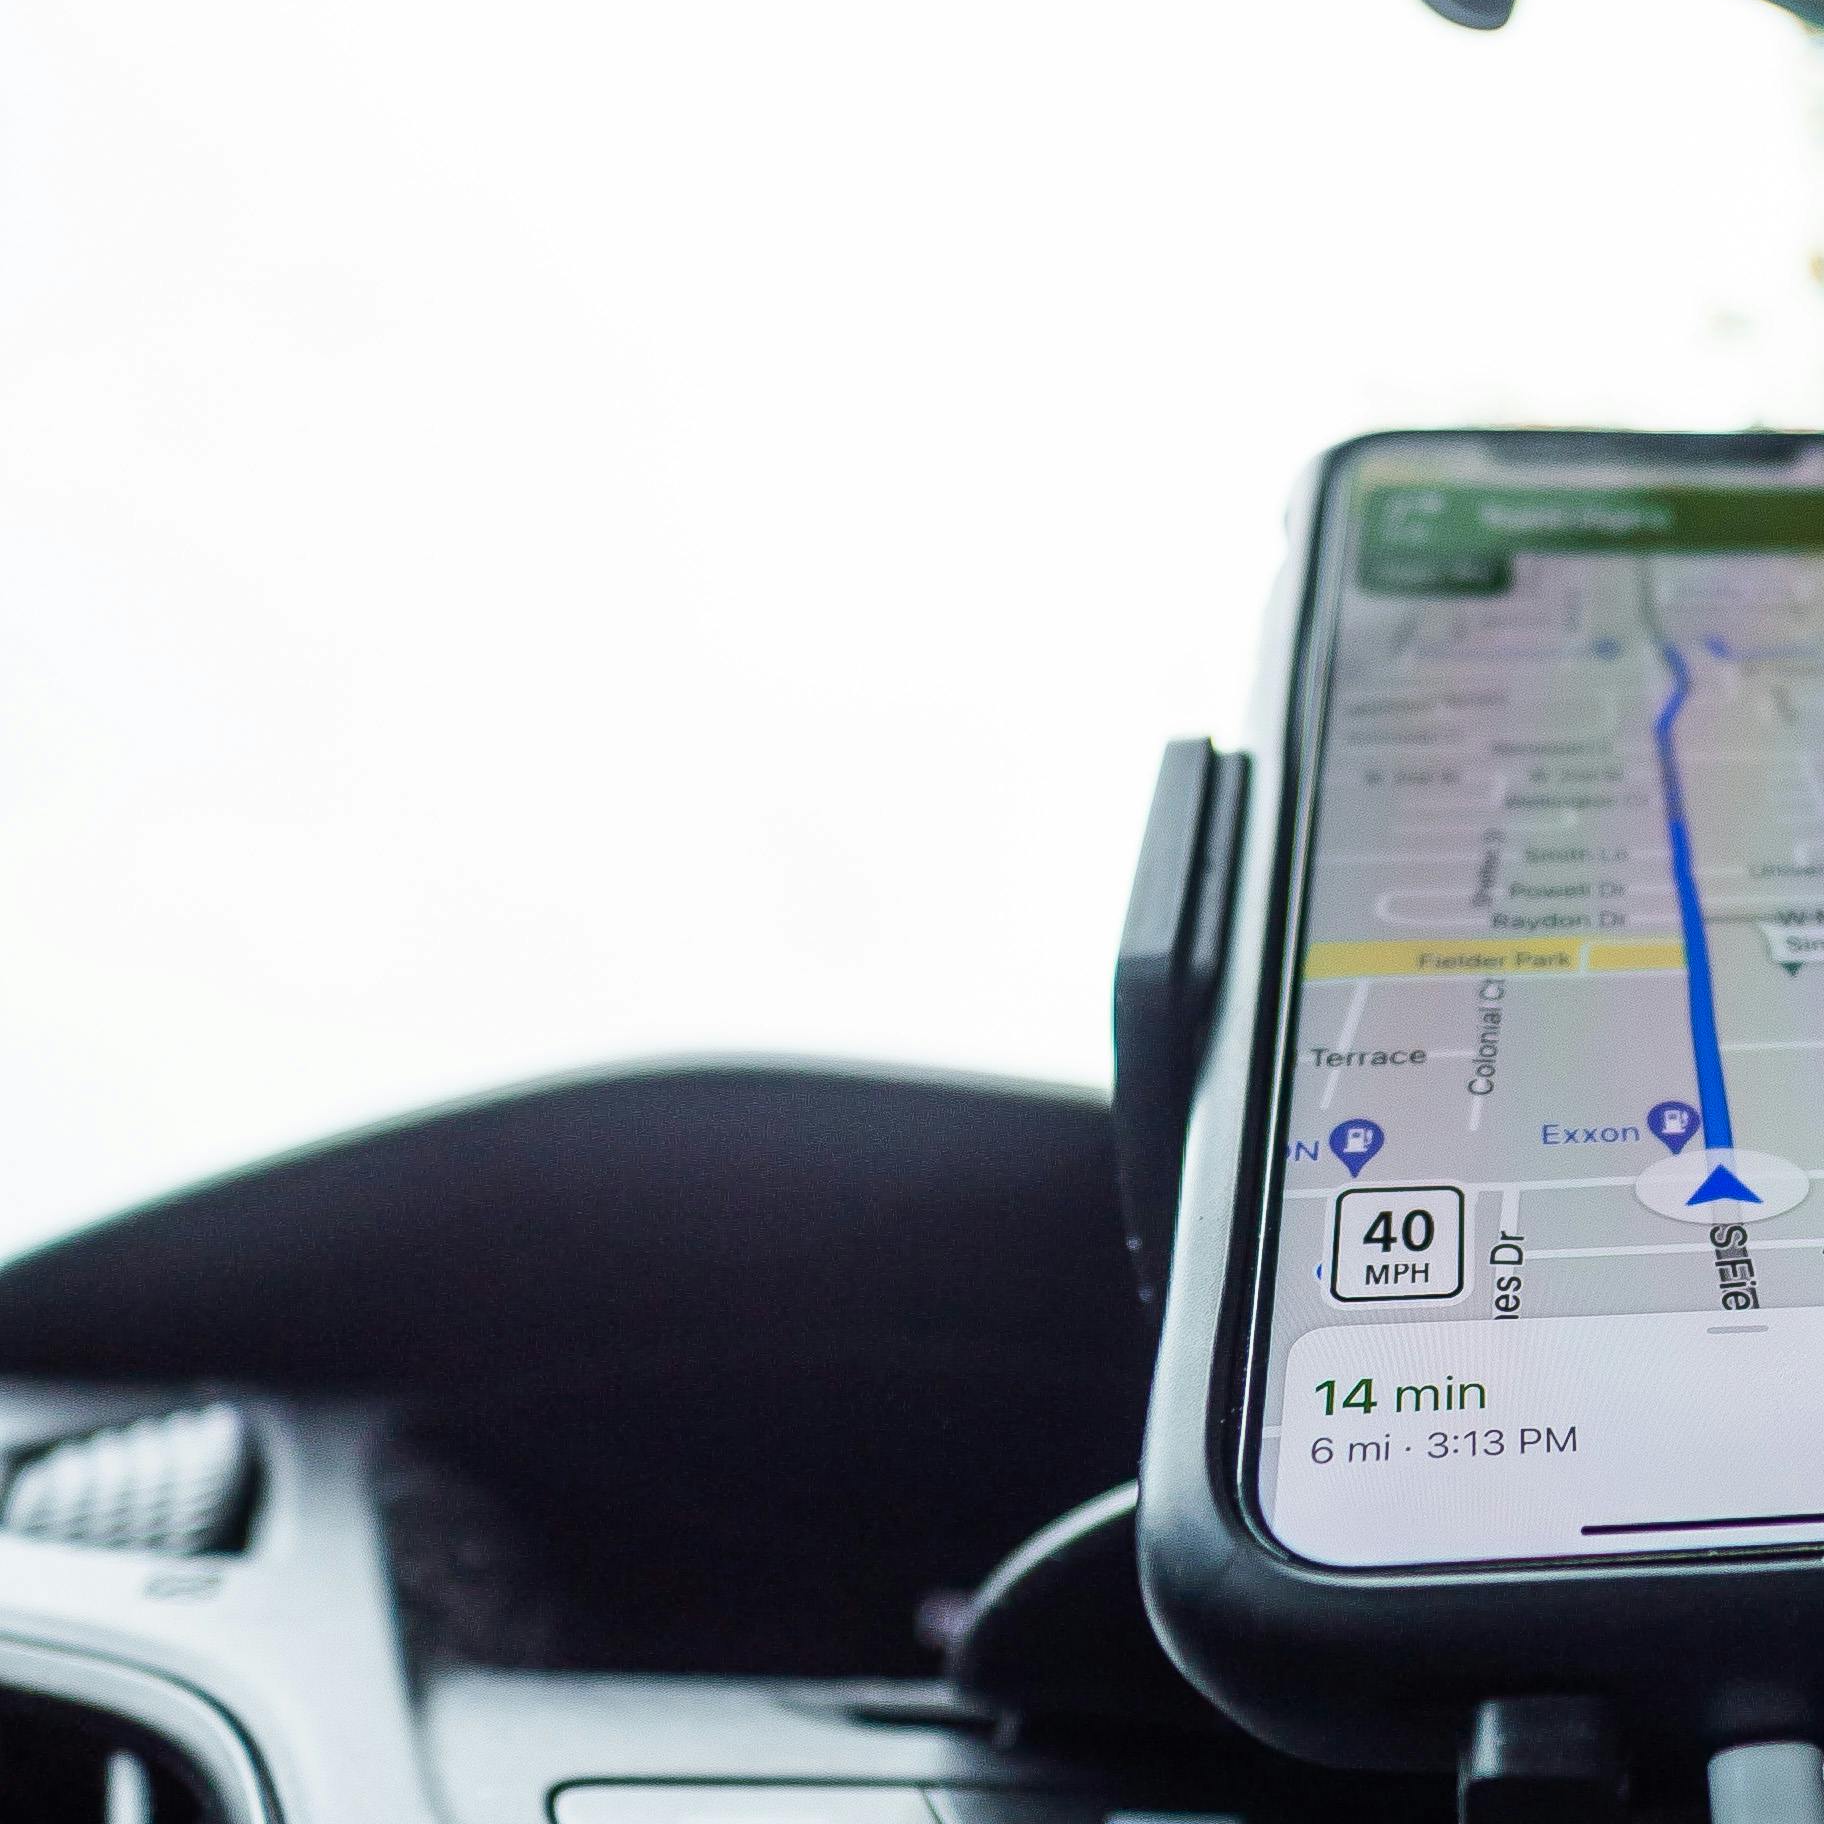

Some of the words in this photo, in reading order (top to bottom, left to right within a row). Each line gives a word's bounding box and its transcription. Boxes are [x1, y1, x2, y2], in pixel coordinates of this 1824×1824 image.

[1491, 912, 1592, 931] Raydon
[1416, 951, 1504, 969] Fielder
[1515, 950, 1570, 967] Park
[1310, 1048, 1427, 1067] Terrace
[1468, 1007, 1502, 1095] Colonial
[1541, 1124, 1641, 1146] Exxon
[1362, 1208, 1435, 1253] 40
[1709, 1225, 1748, 1248] S
[1489, 1231, 1525, 1266] Dr
[1364, 1262, 1430, 1286] MPH
[1314, 1377, 1378, 1416] 14
[1395, 1375, 1487, 1414] min
[1311, 1437, 1335, 1465] 6
[1348, 1433, 1391, 1463] mi
[1427, 1428, 1505, 1460] 3:13
[1519, 1425, 1578, 1455] PM
